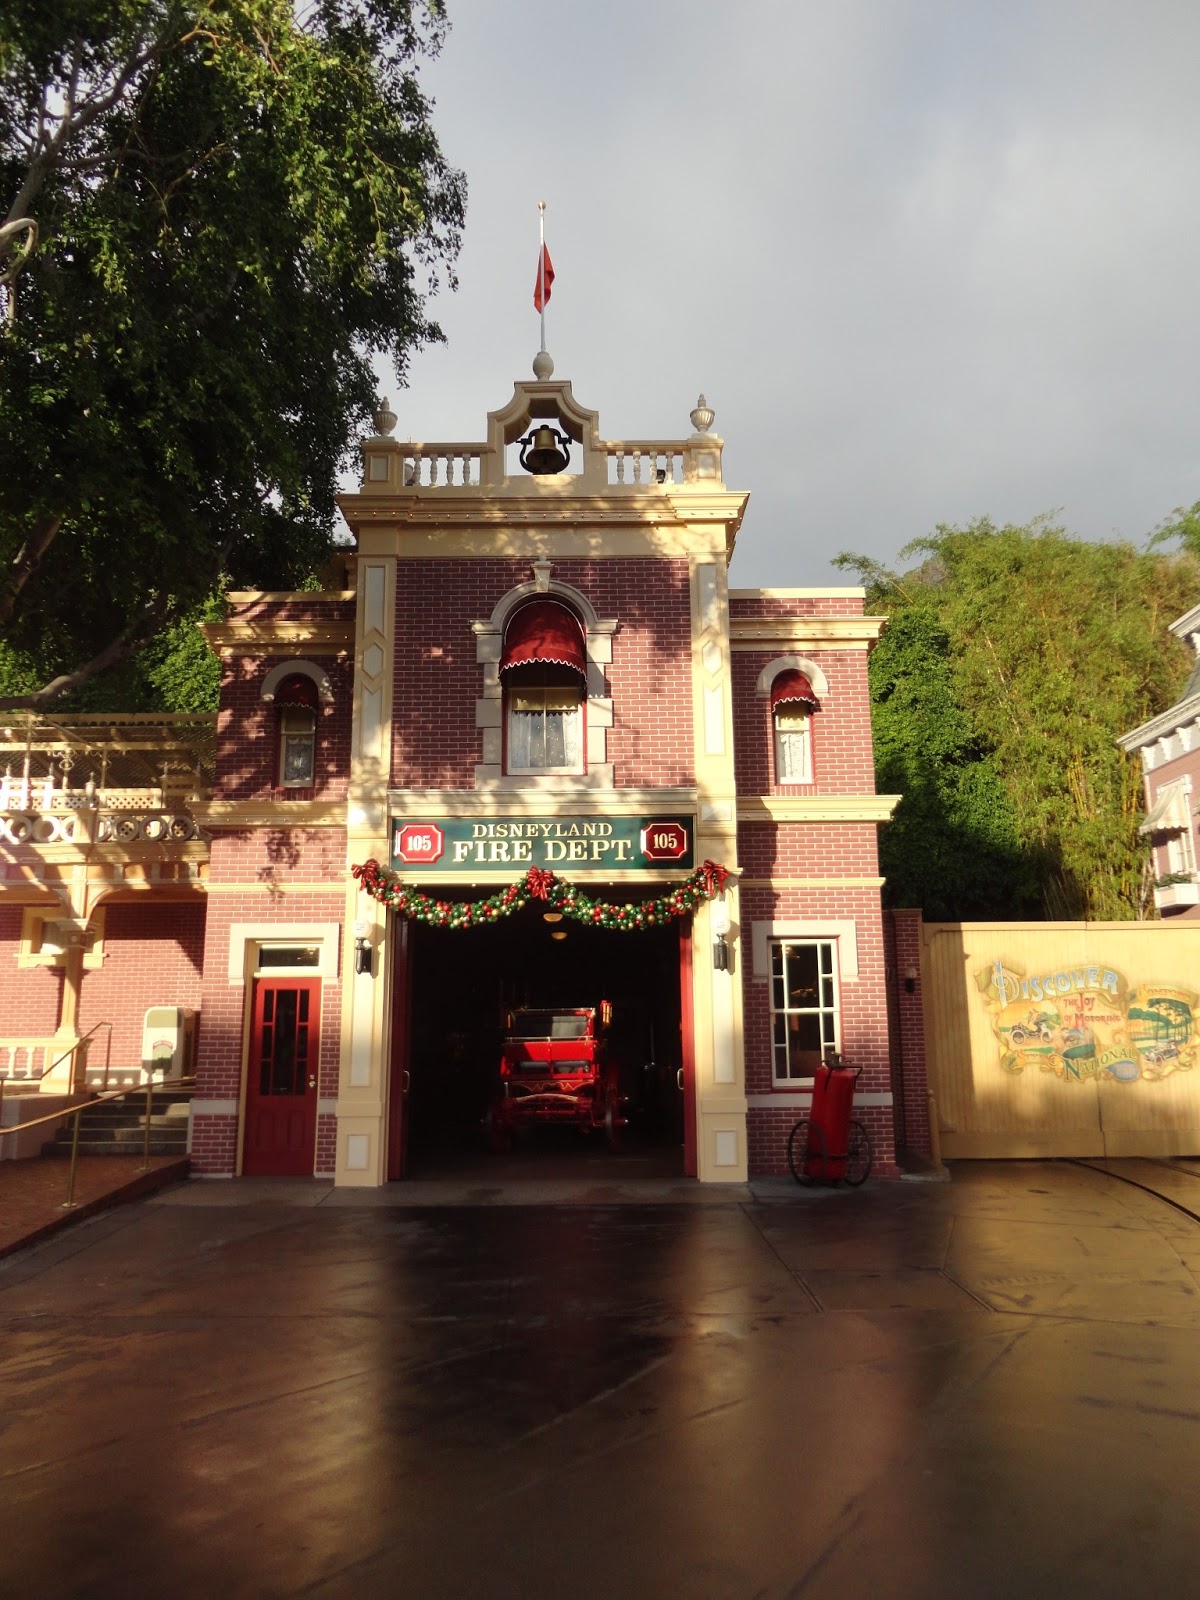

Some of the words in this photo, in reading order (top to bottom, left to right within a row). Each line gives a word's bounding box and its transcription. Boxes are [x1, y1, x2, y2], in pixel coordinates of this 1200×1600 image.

[472, 822, 613, 838] DISNEYLAND
[407, 834, 432, 851] 105
[653, 833, 678, 849] 105
[452, 840, 532, 862] FIRE
[543, 839, 635, 861] DEPT.
[992, 960, 1120, 1008] DISCOVER
[1064, 998, 1078, 1008] THE
[1077, 992, 1095, 1012] JOY
[1073, 1013, 1121, 1029] MOTORING
[1063, 1047, 1137, 1081] NATIONAL
